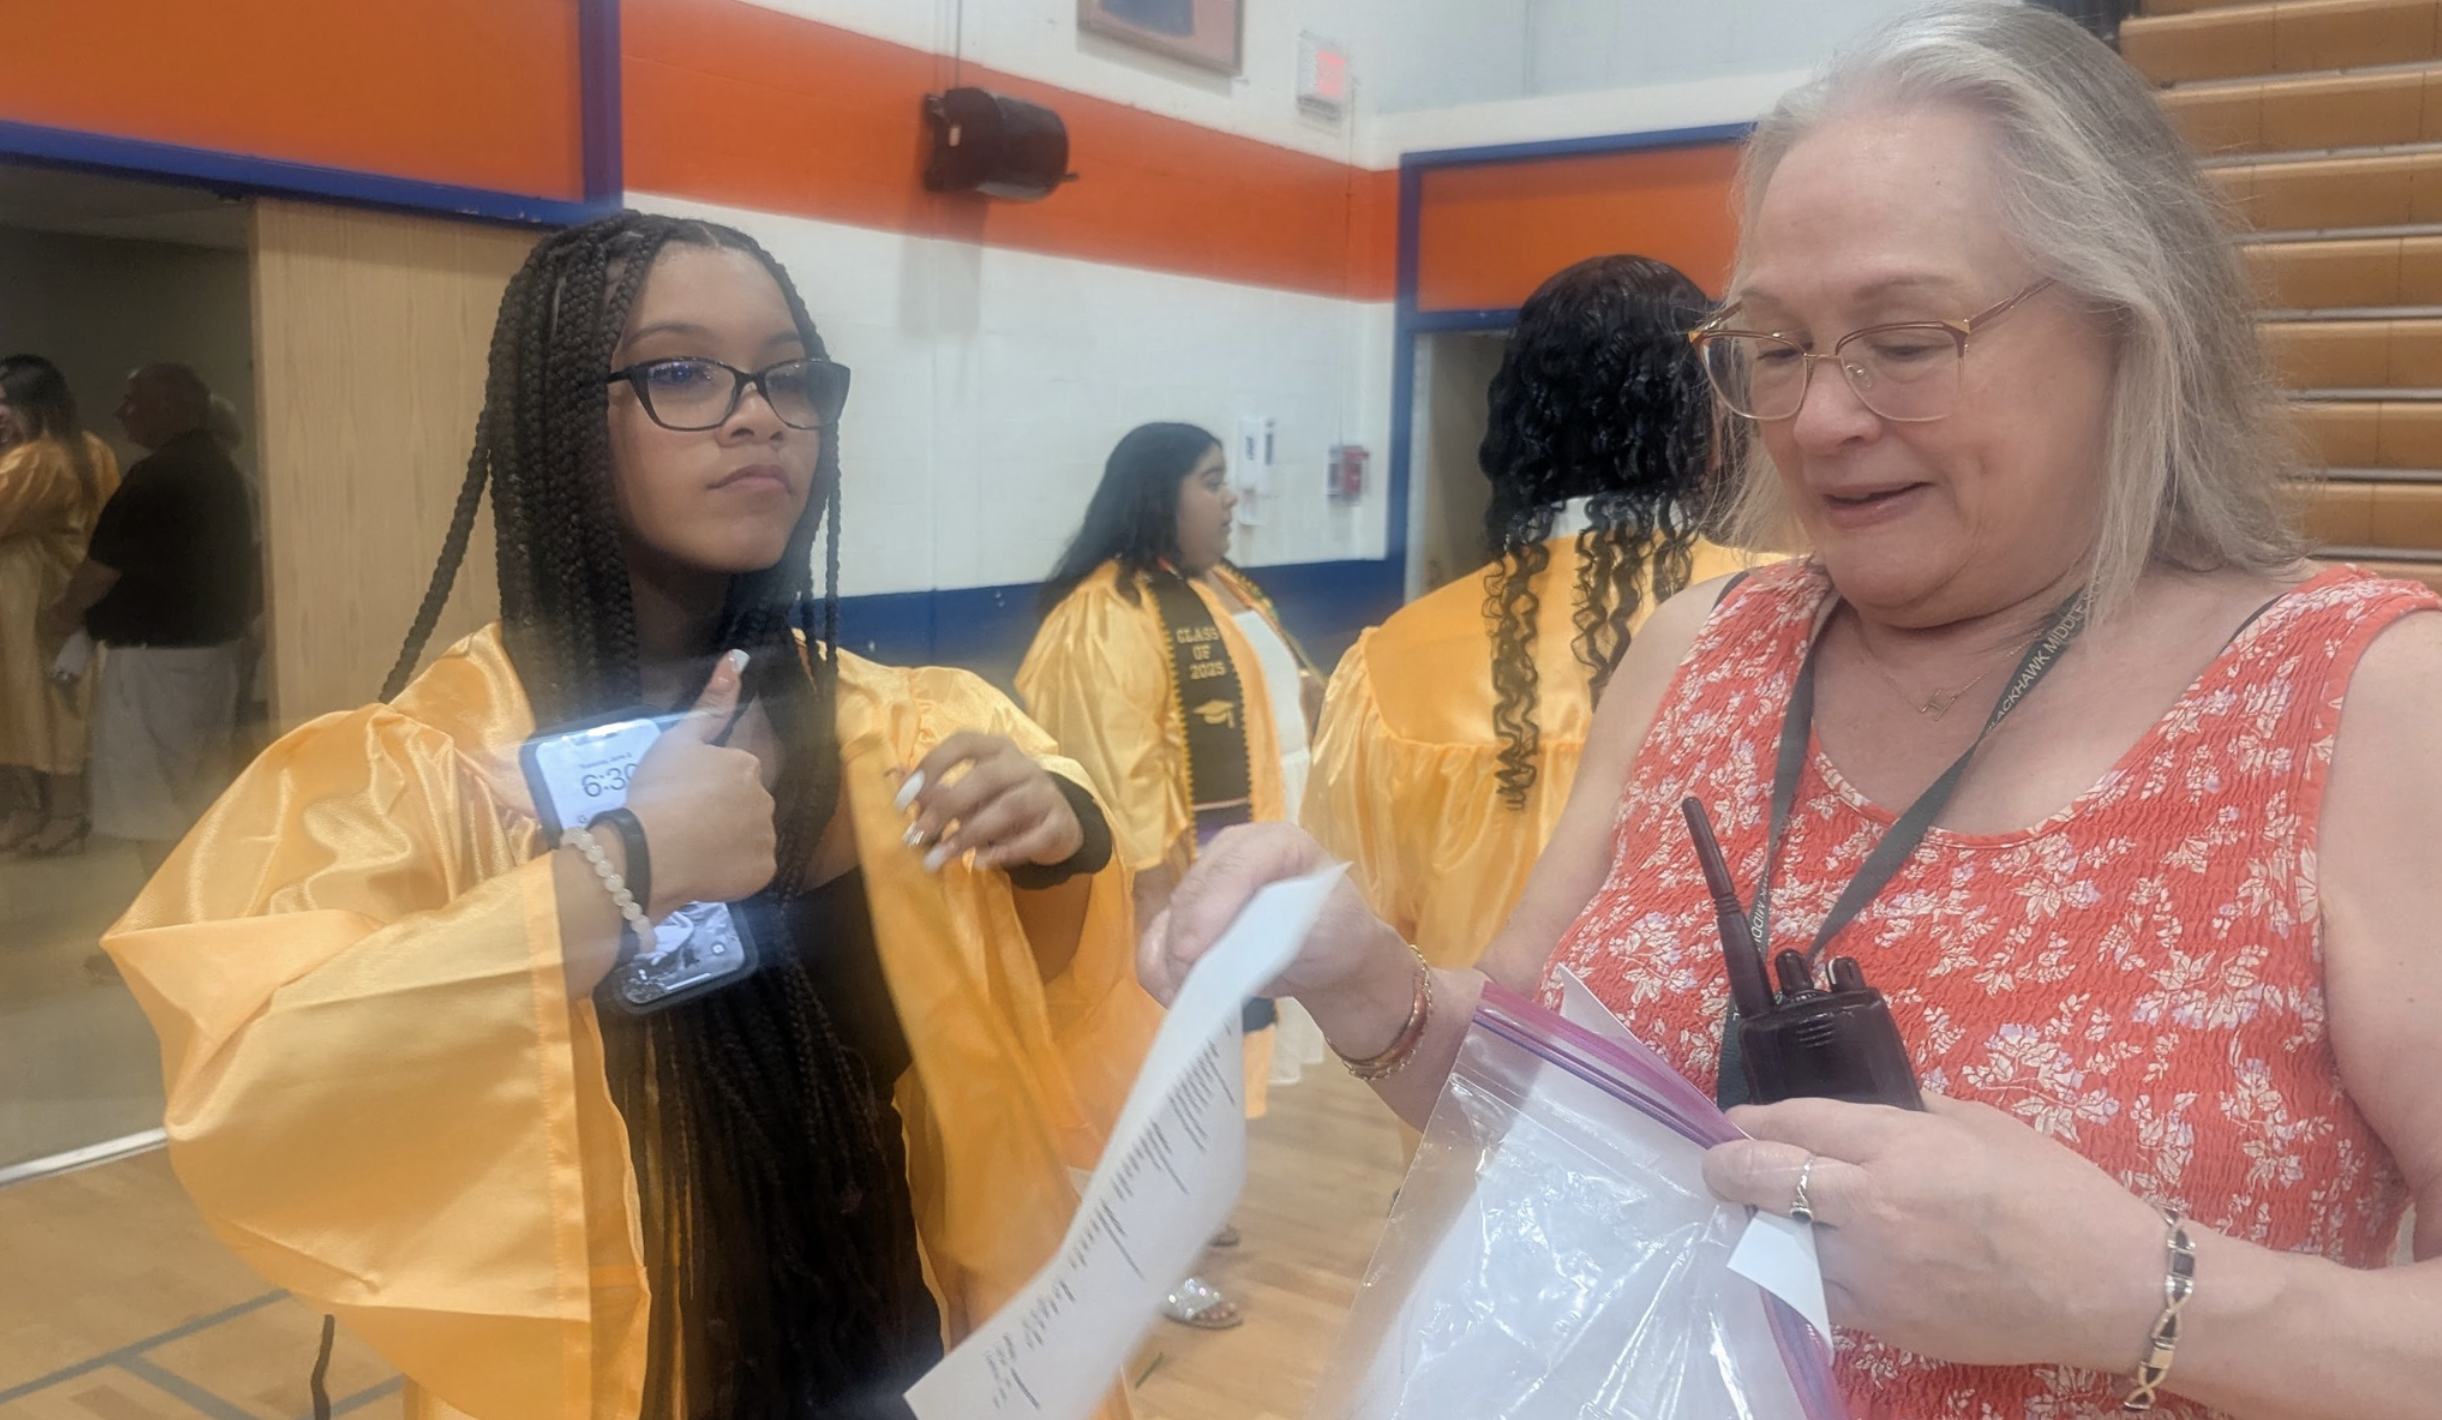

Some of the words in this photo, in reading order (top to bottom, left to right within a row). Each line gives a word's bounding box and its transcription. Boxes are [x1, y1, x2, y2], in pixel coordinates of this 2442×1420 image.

[1176, 627, 1219, 643] CLASS
[1193, 645, 1211, 660] OF
[1190, 662, 1226, 679] 2025
